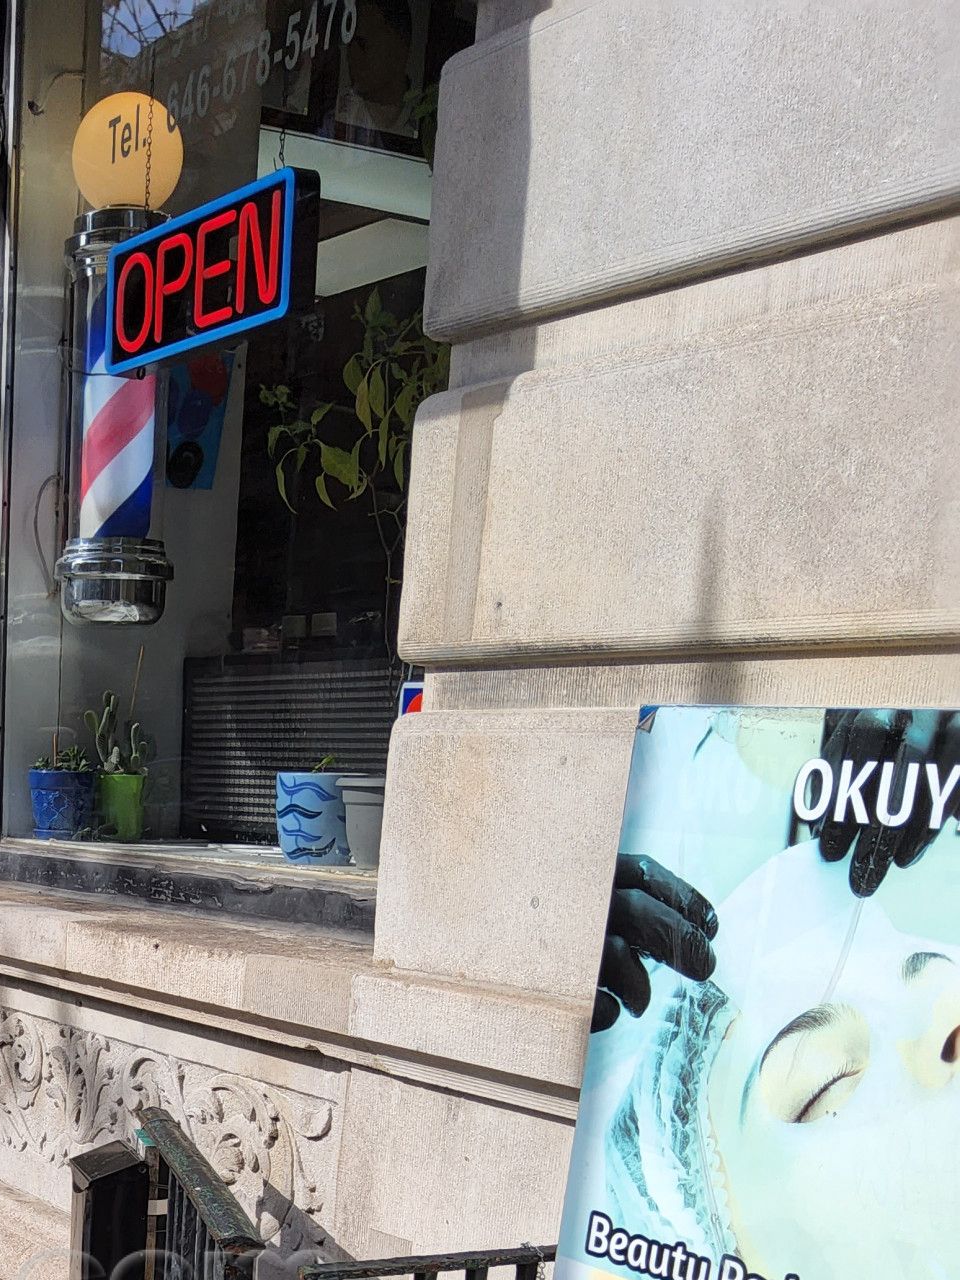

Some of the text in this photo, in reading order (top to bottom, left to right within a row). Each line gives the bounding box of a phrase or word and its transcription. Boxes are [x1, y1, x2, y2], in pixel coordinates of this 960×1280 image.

[108, 104, 148, 164] Tel.
[115, 189, 283, 353] OPEN
[793, 758, 960, 832] OKUY
